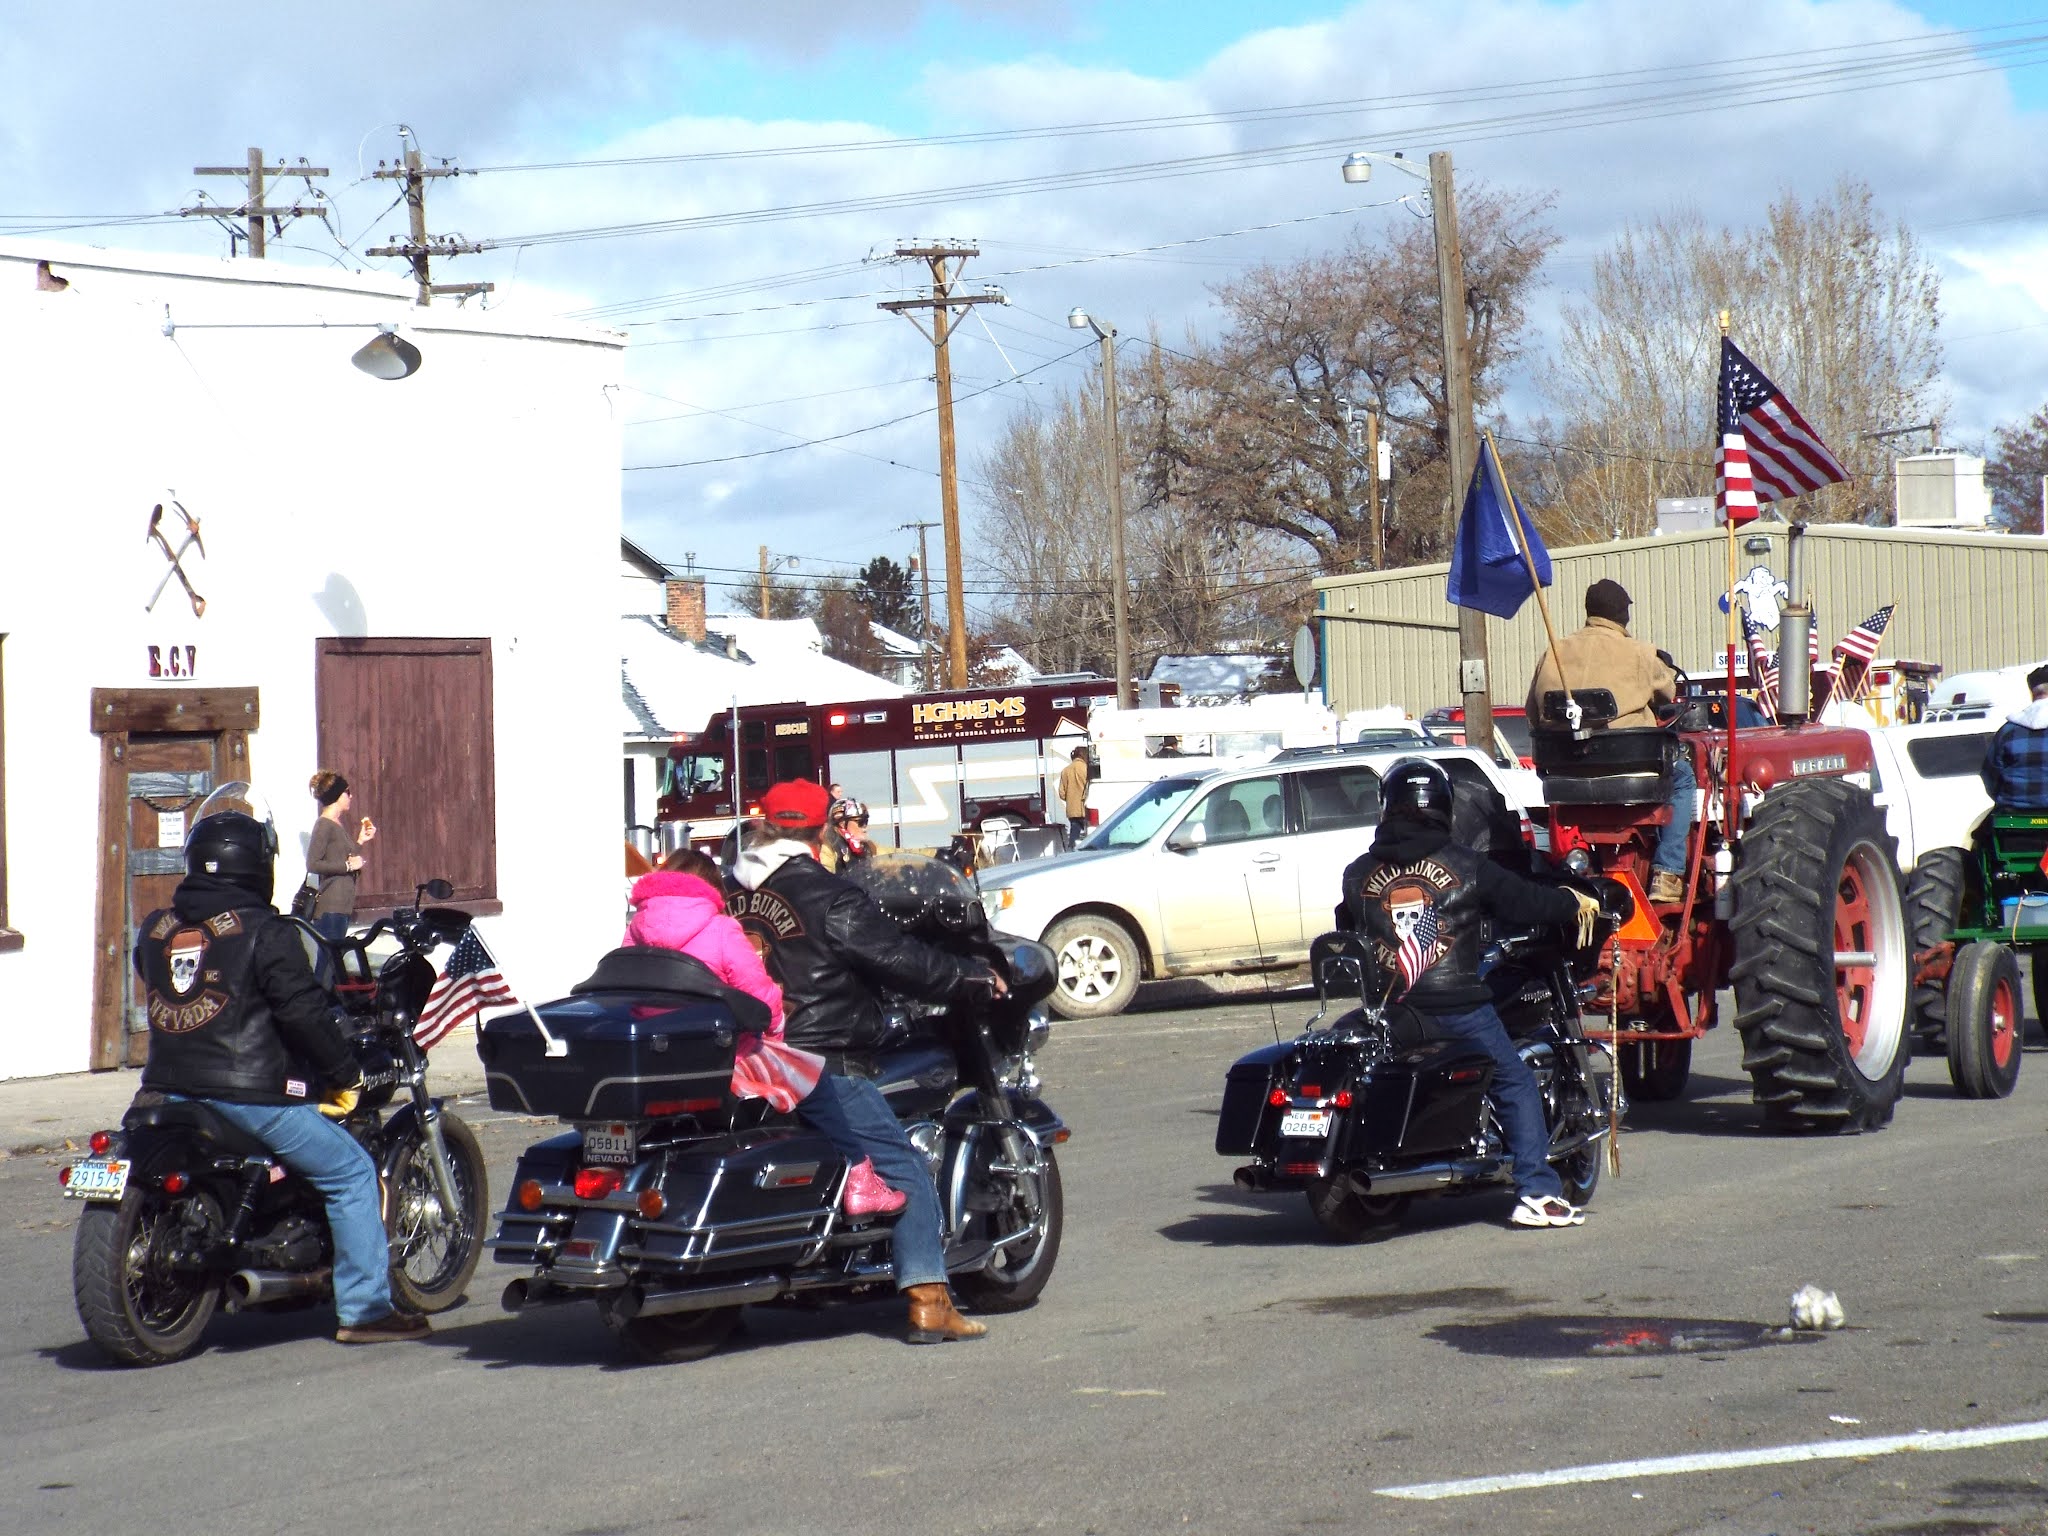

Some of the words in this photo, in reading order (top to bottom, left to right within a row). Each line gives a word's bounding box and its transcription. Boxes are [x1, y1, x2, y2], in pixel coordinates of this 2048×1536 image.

[775, 722, 808, 736] RESCUE
[914, 718, 1026, 732] RESCUE
[750, 892, 797, 937] BUNCH
[206, 972, 219, 981] MC
[149, 996, 220, 1030] NEVADA
[586, 1154, 629, 1163] NEVADA
